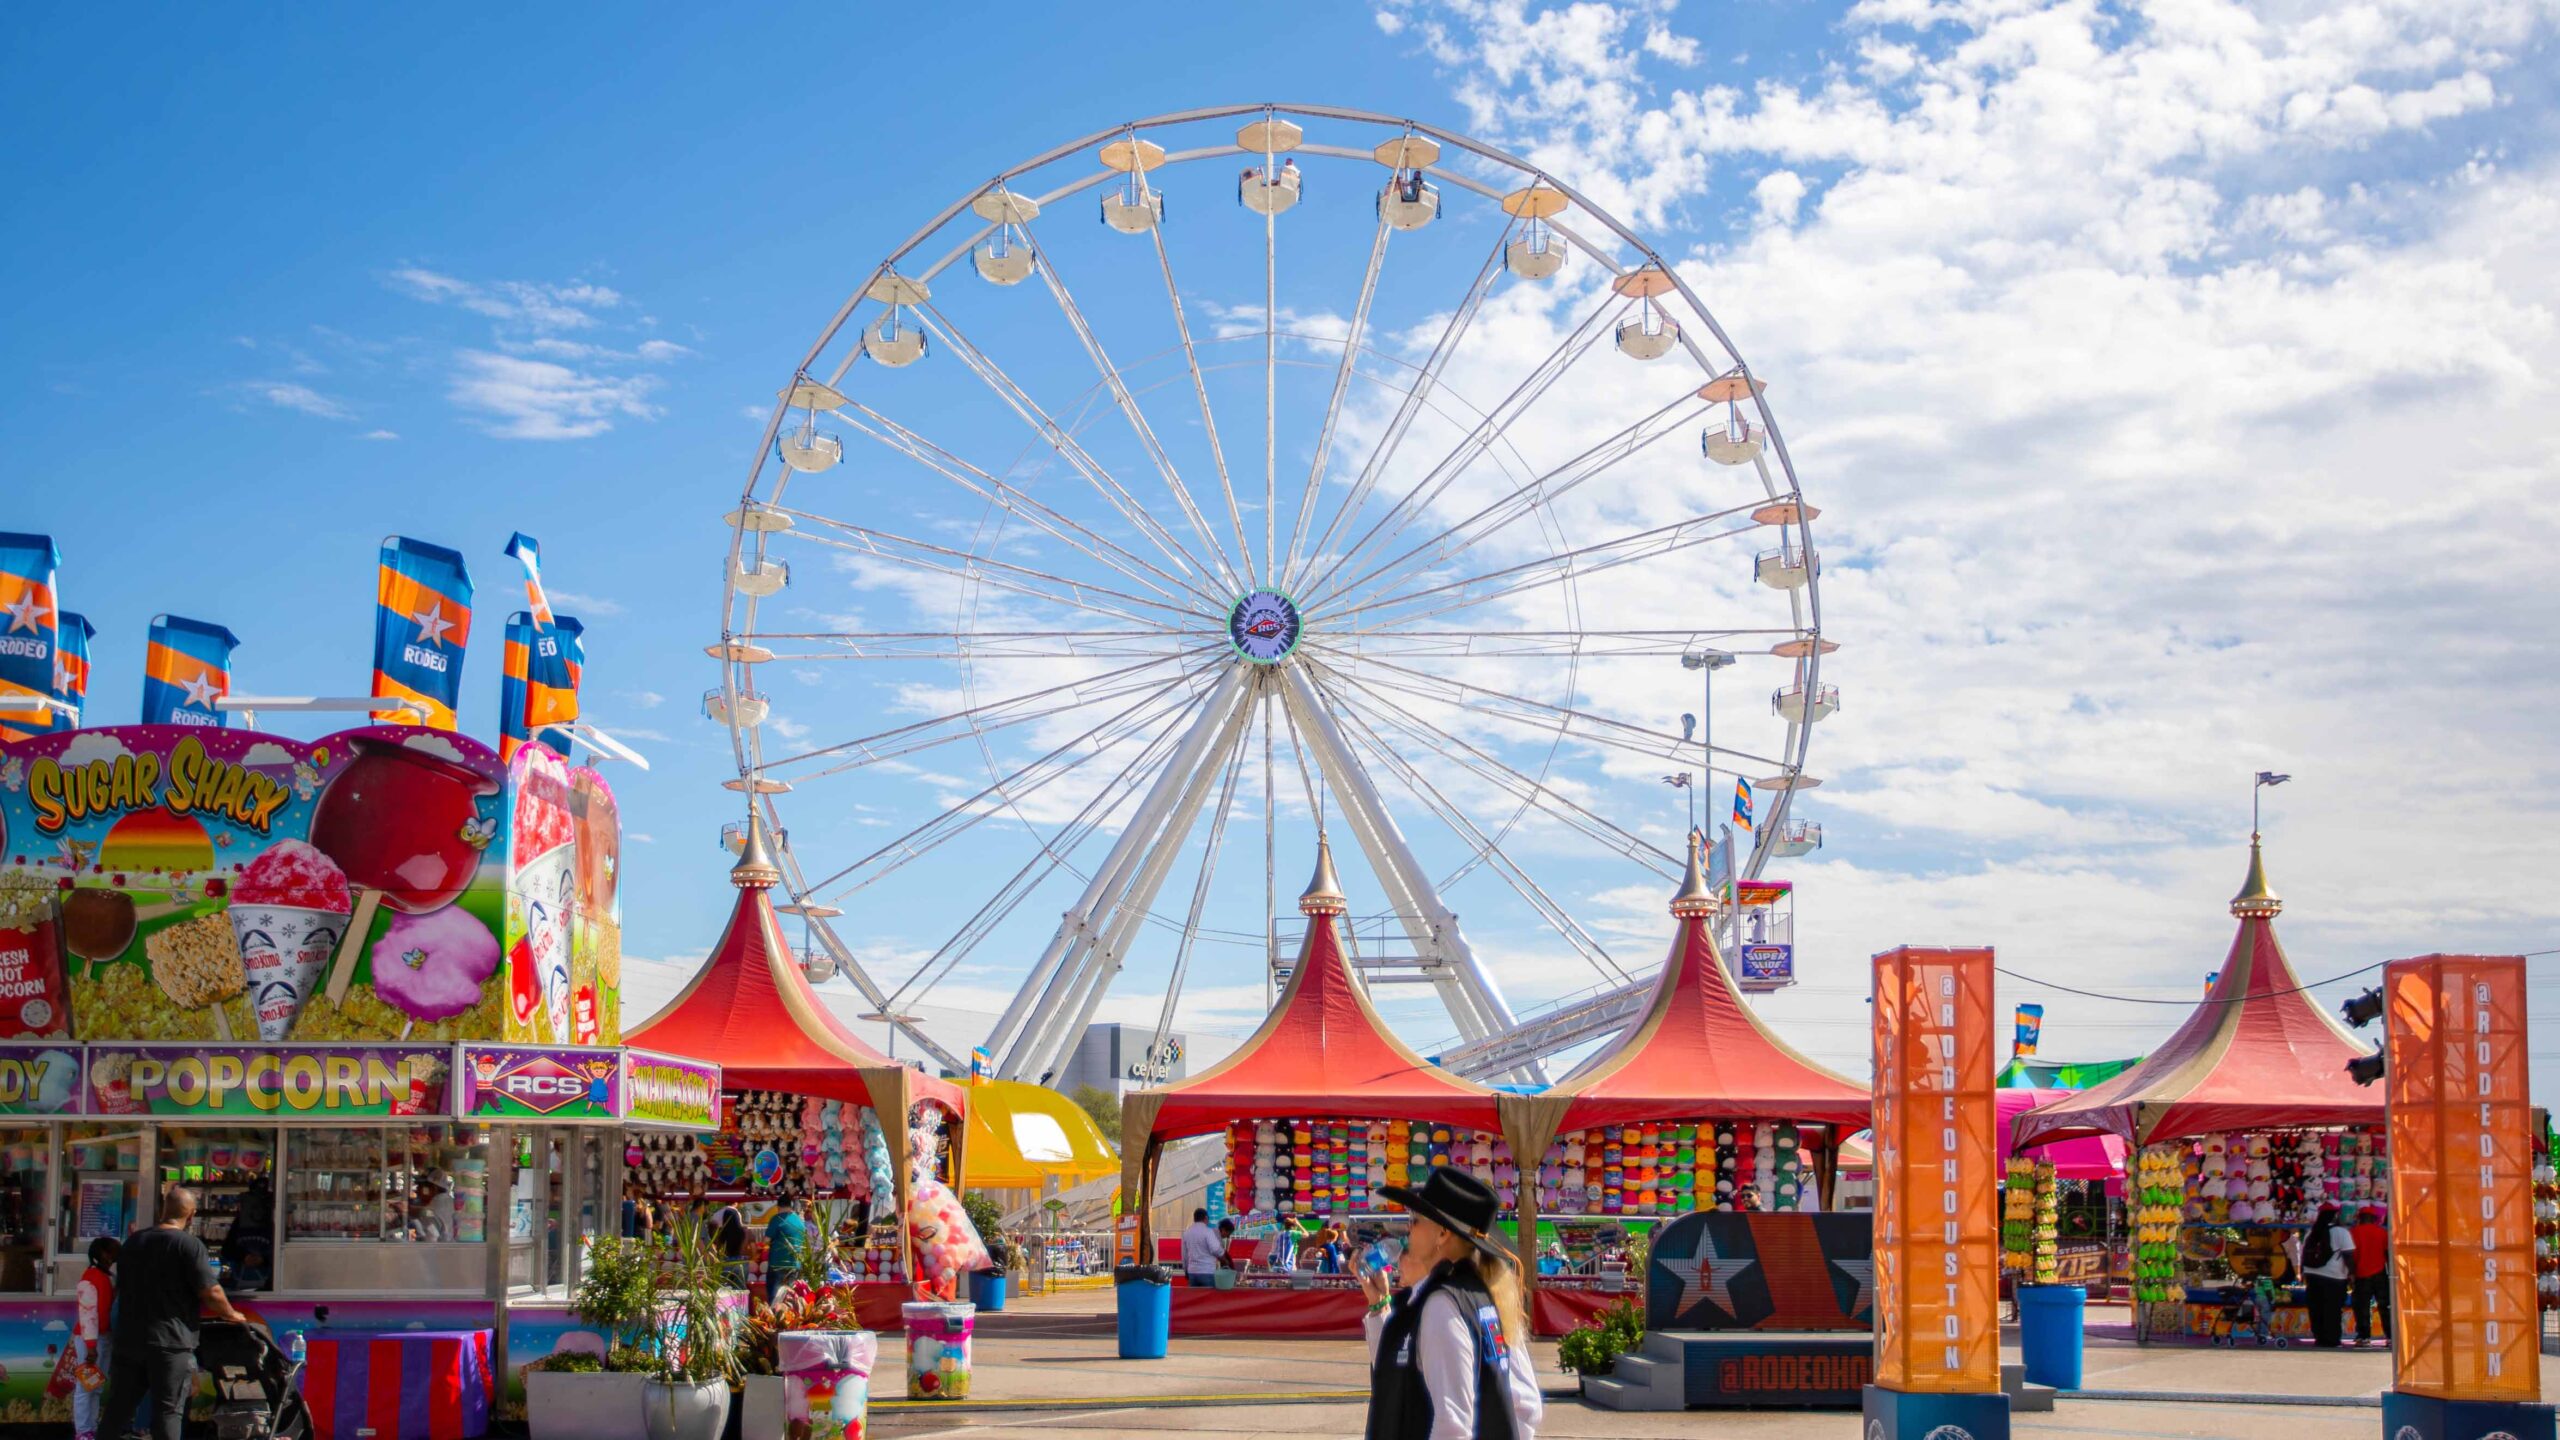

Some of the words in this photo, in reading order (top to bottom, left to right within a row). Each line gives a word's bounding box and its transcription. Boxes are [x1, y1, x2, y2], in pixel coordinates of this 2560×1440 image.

[0, 641, 47, 659] RODEO
[403, 647, 448, 672] RODEO
[171, 710, 219, 727] RODEO
[29, 751, 160, 832] SUGAR
[165, 735, 291, 833] SHACK
[1744, 952, 1788, 962] SUPER
[1751, 961, 1782, 970] SLIDE
[130, 1054, 412, 1111] POPCORN
[506, 1074, 583, 1096] RCS
[1939, 974, 1960, 1369] @RODEOHOUSTON
[2475, 982, 2501, 1377] @RODEOHOUSTON
[2072, 1244, 2099, 1254] PASS
[1719, 1355, 1874, 1394] @RODEOHO
